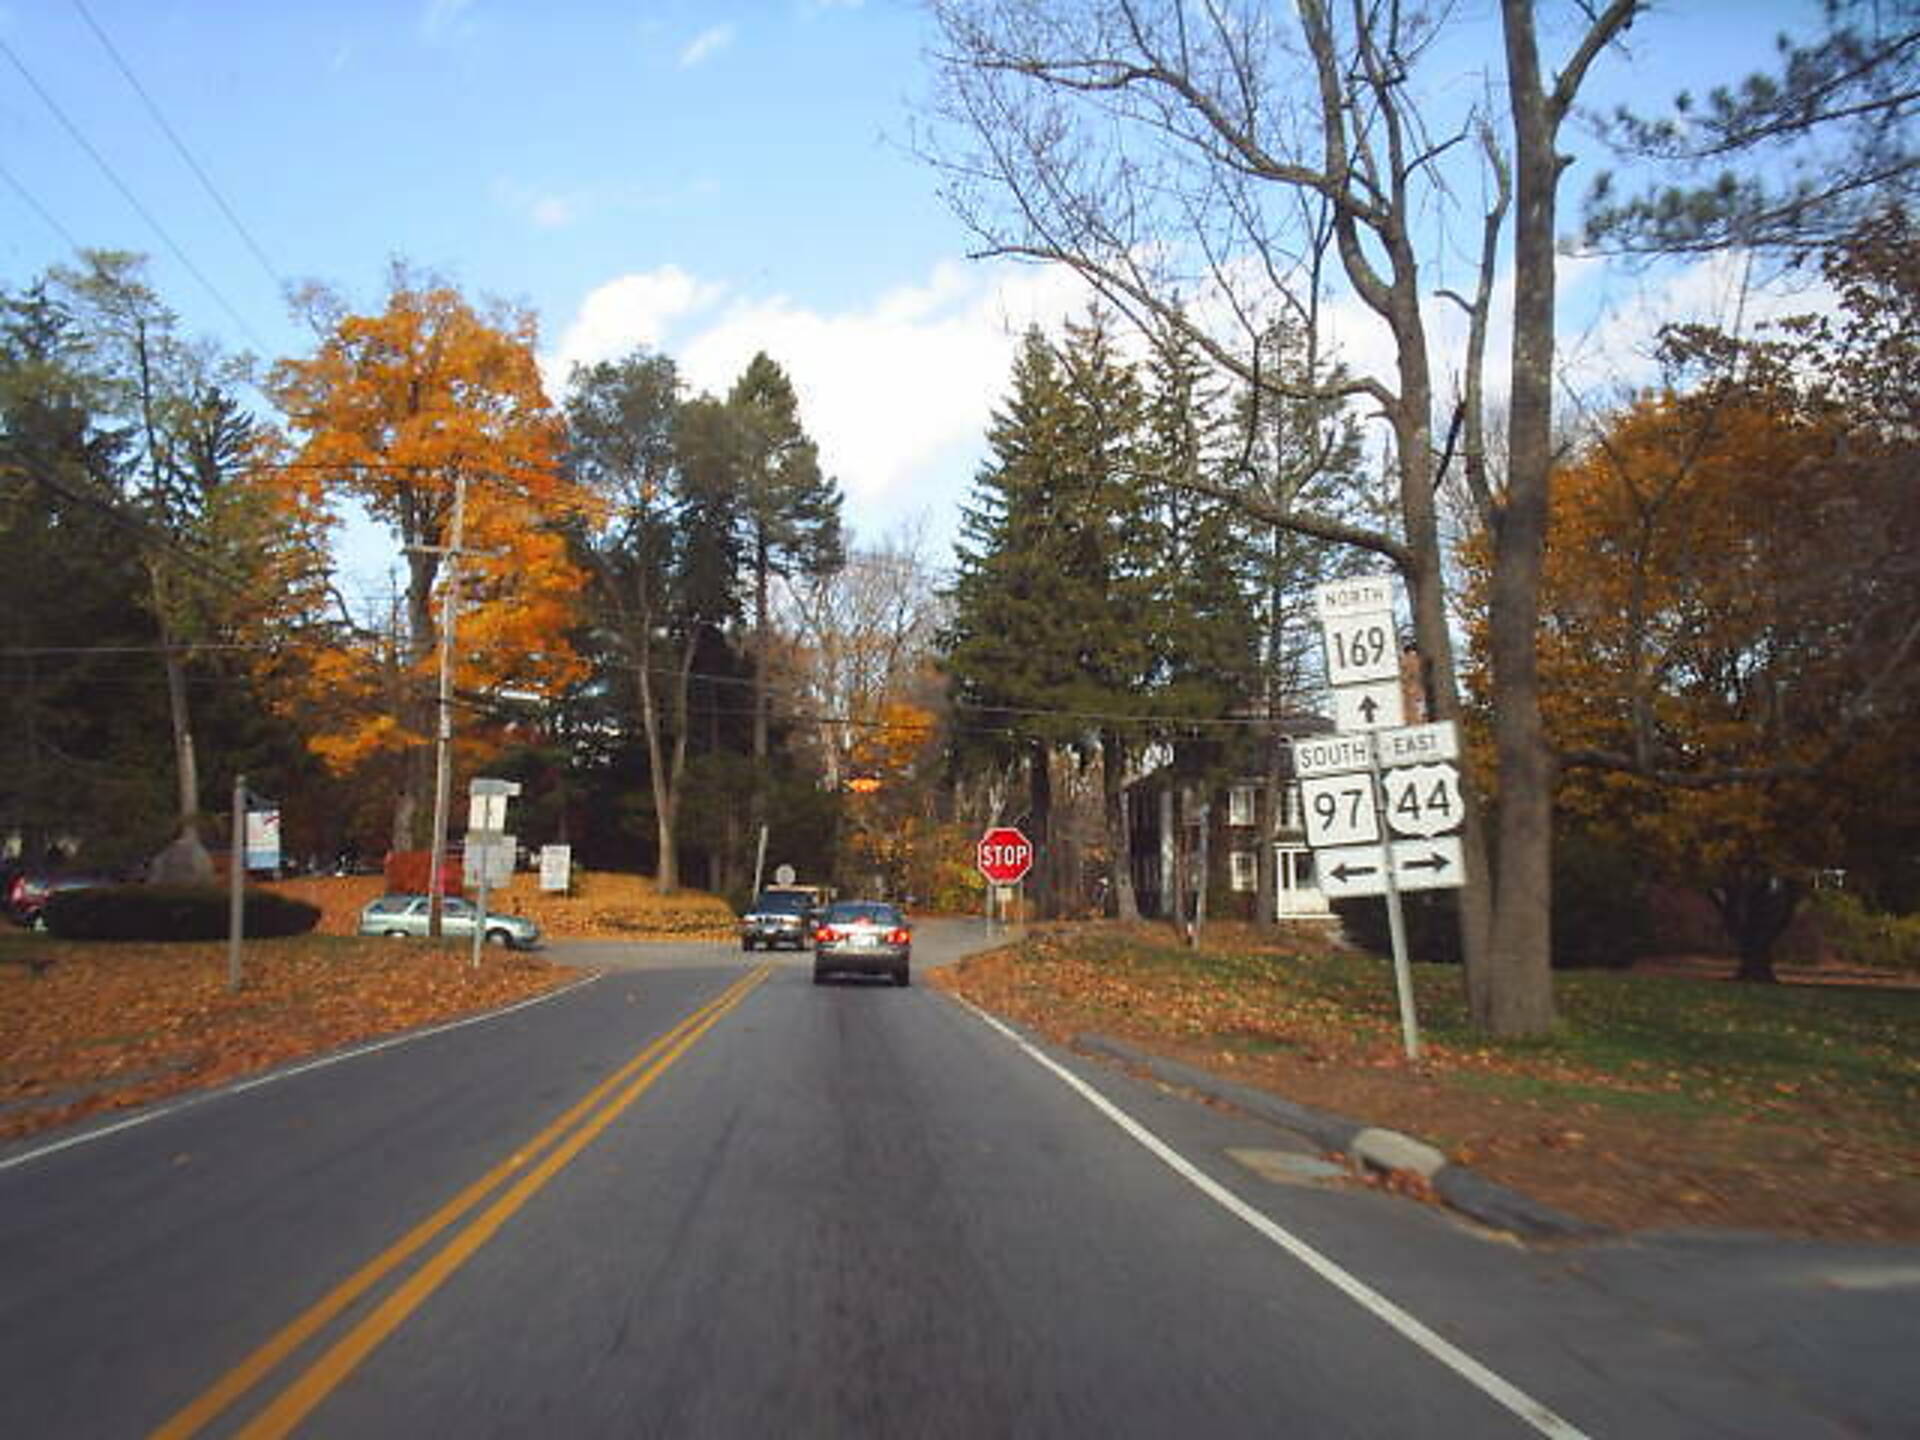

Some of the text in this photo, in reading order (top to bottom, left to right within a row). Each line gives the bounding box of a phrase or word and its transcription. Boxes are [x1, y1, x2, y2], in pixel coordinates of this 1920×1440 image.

[1325, 587, 1384, 606] NORTH
[1333, 626, 1385, 669] 169
[1300, 743, 1366, 769] SOUTH
[1393, 734, 1437, 754] EAST
[1313, 789, 1364, 831] 97
[1397, 778, 1451, 820] 44
[982, 844, 1027, 867] STOP
